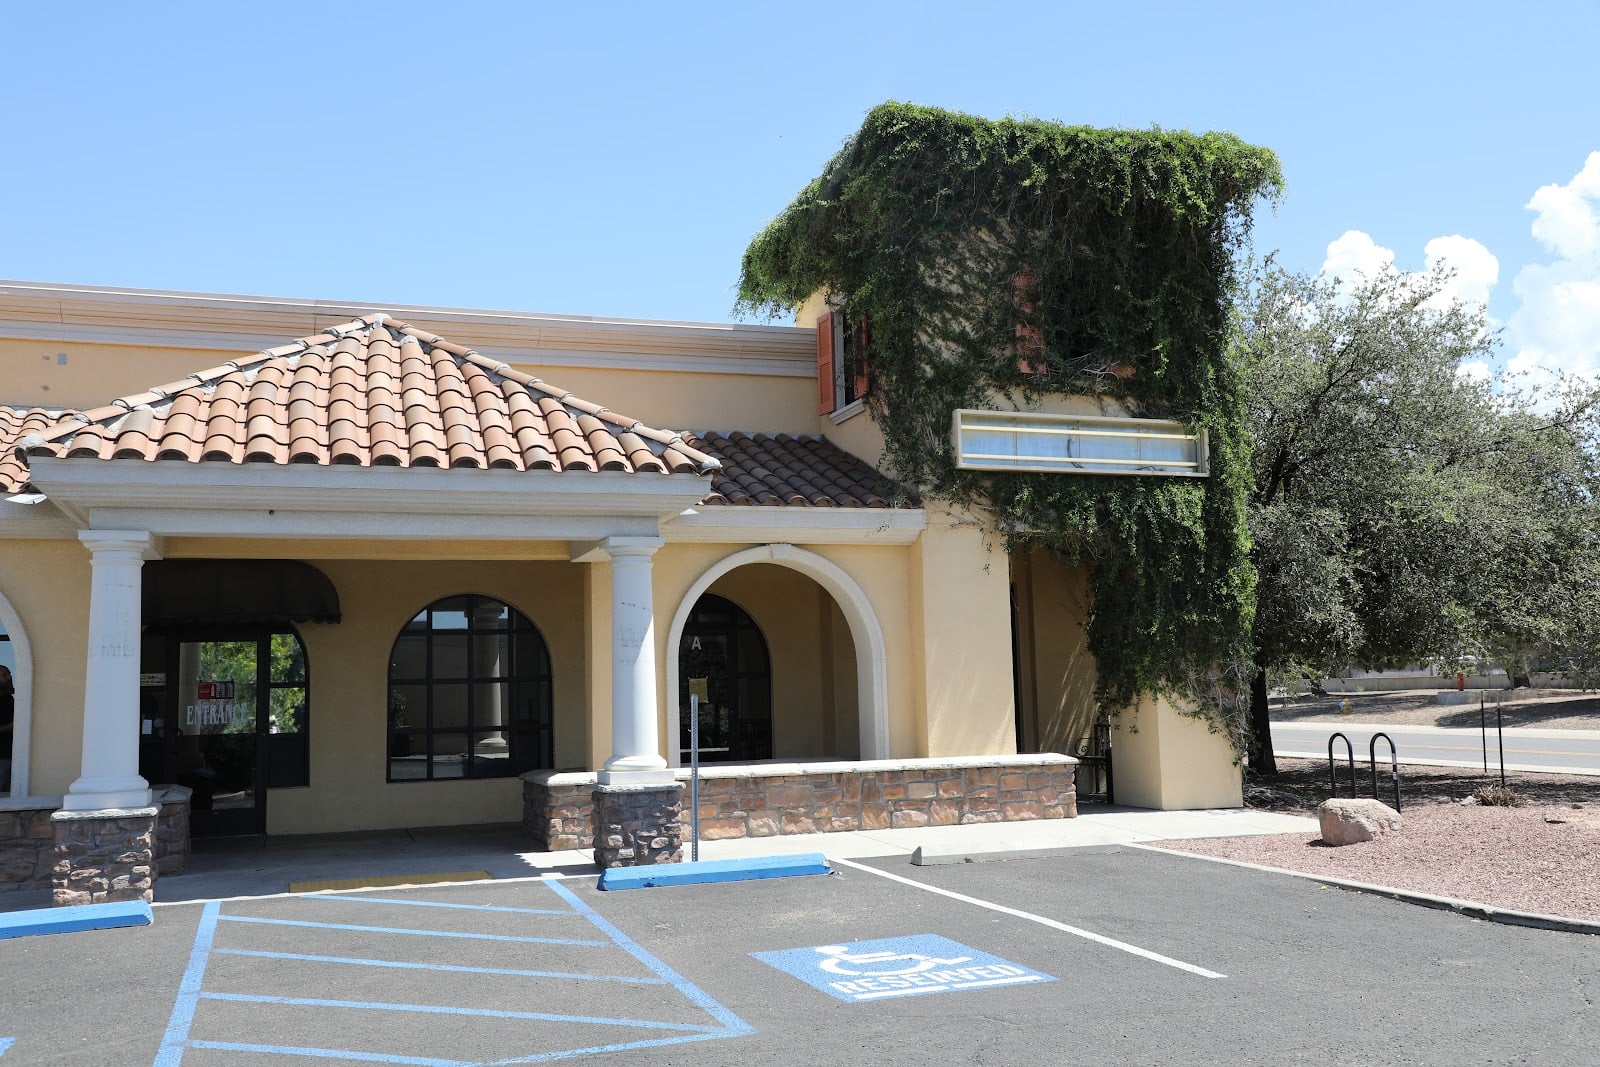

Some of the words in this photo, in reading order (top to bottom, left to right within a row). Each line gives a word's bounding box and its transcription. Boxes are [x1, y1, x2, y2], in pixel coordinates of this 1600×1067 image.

[691, 636, 701, 650] A
[186, 703, 248, 725] ENTRANCE
[829, 964, 1025, 993] RESERVED
